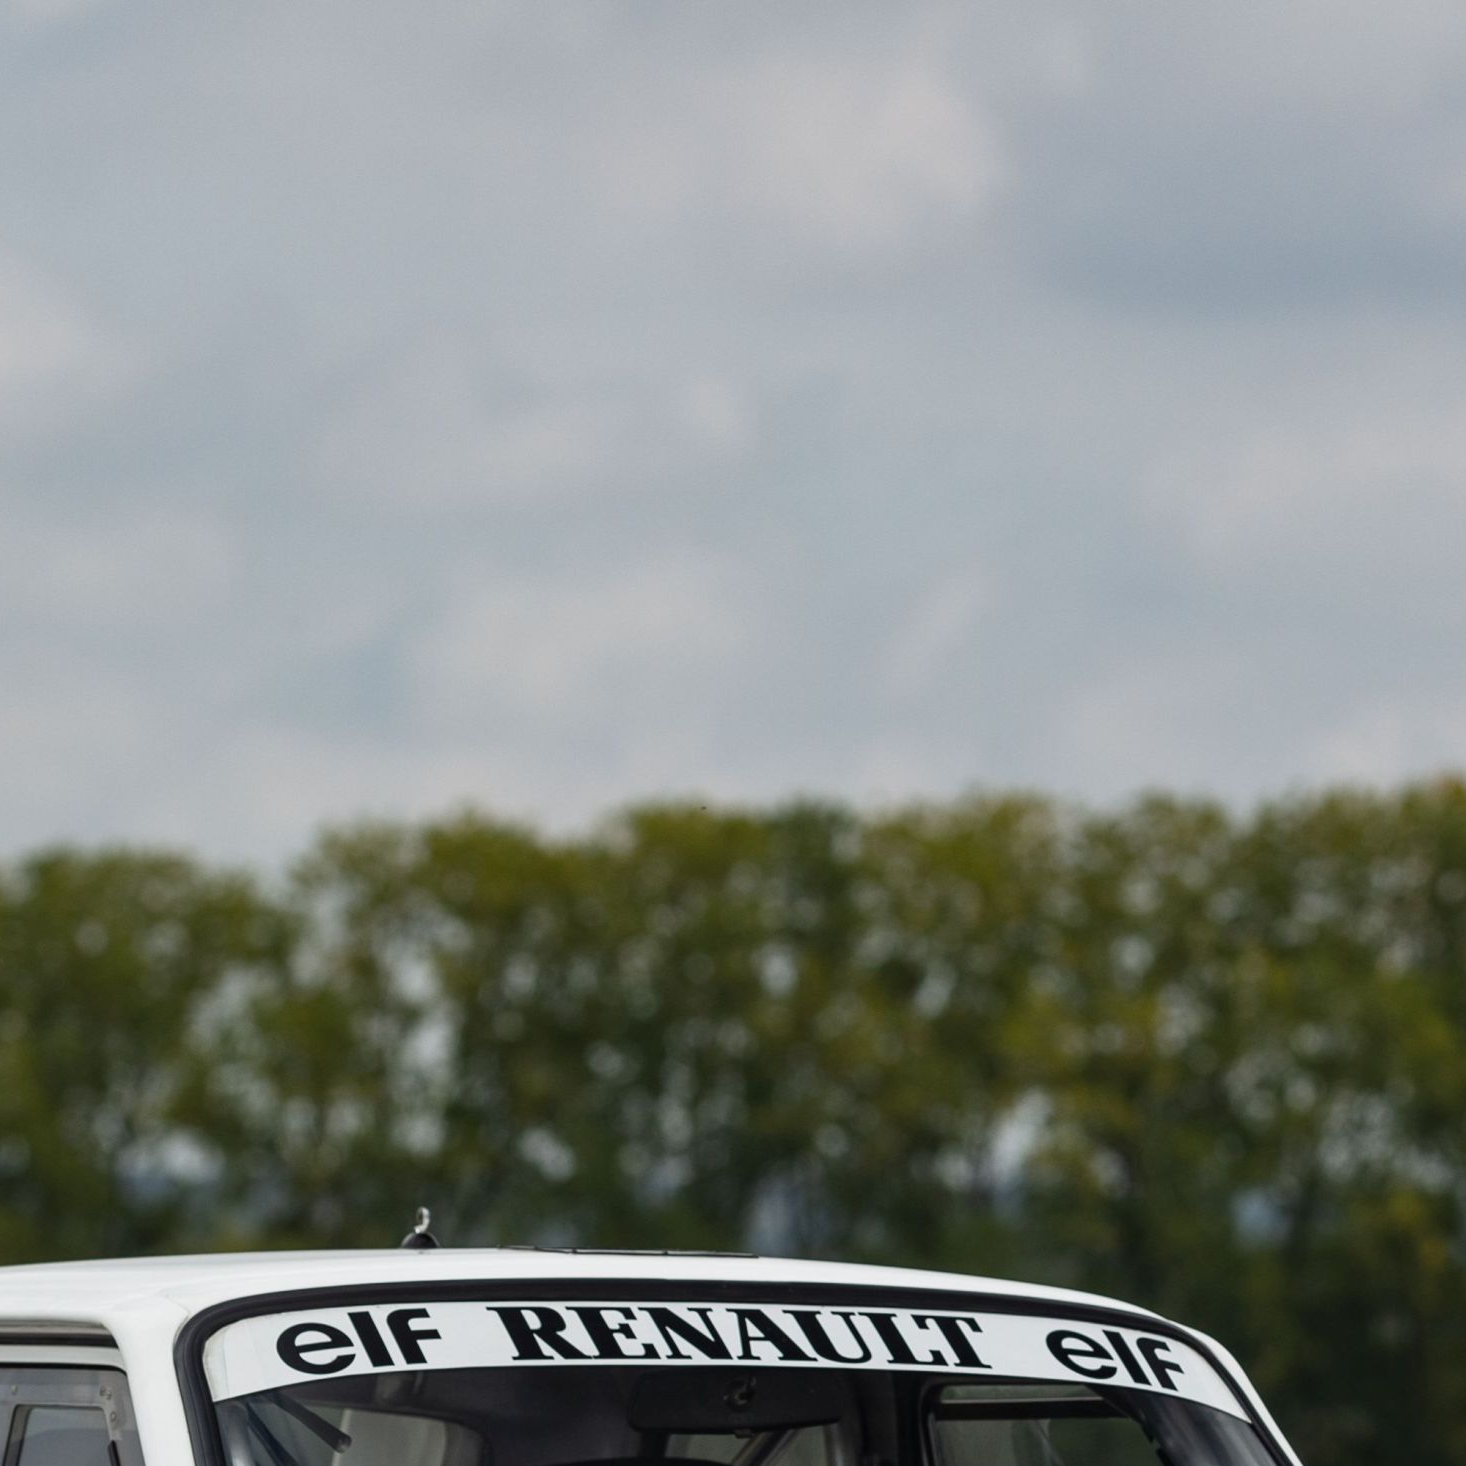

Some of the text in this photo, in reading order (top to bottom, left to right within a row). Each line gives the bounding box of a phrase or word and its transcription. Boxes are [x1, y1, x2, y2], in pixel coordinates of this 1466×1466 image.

[276, 1305, 1185, 1391] elf RENAULT elf
